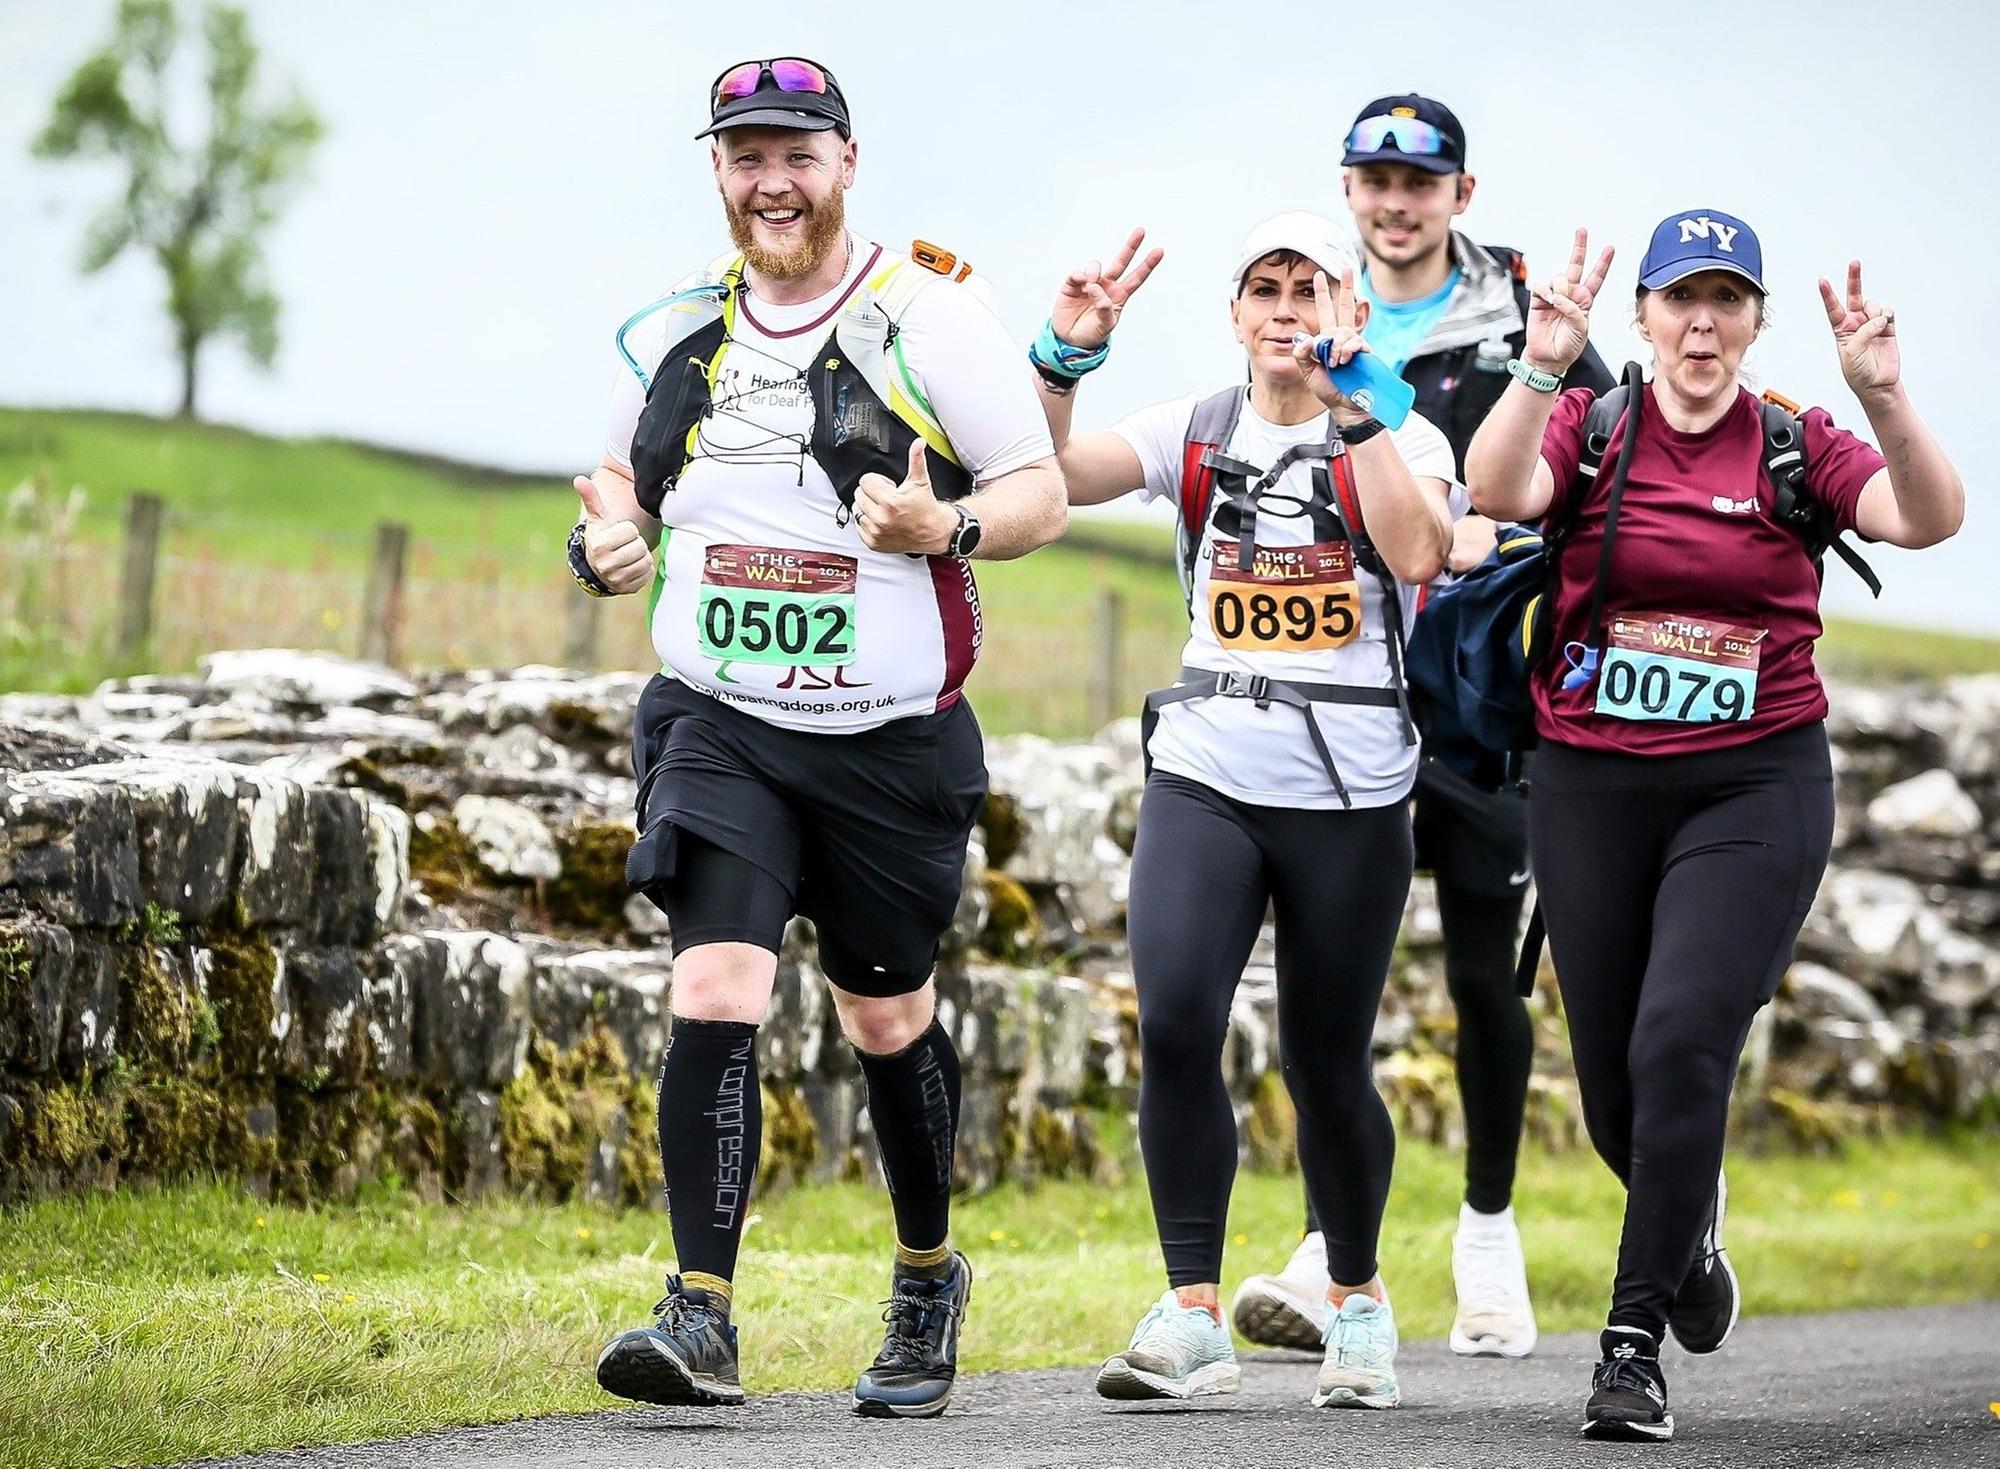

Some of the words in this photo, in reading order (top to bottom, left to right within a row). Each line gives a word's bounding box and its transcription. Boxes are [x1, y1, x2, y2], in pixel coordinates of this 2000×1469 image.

[1677, 216, 1739, 253] NY
[751, 373, 809, 395] Hearing
[748, 394, 766, 405] for
[769, 394, 802, 408] Deaf
[755, 553, 796, 568] THE
[1261, 550, 1297, 564] THE
[1318, 558, 1346, 569] 2024
[744, 565, 813, 585] WALL
[818, 568, 850, 580] 2024
[1252, 562, 1315, 580] WALL
[705, 597, 848, 655] 0502
[1214, 591, 1354, 642] 0895
[1663, 620, 1705, 638] THE
[1650, 631, 1718, 658] WALL
[1724, 640, 1752, 656] 2024
[1604, 660, 1745, 722] 0079
[703, 1064, 747, 1230] compression
